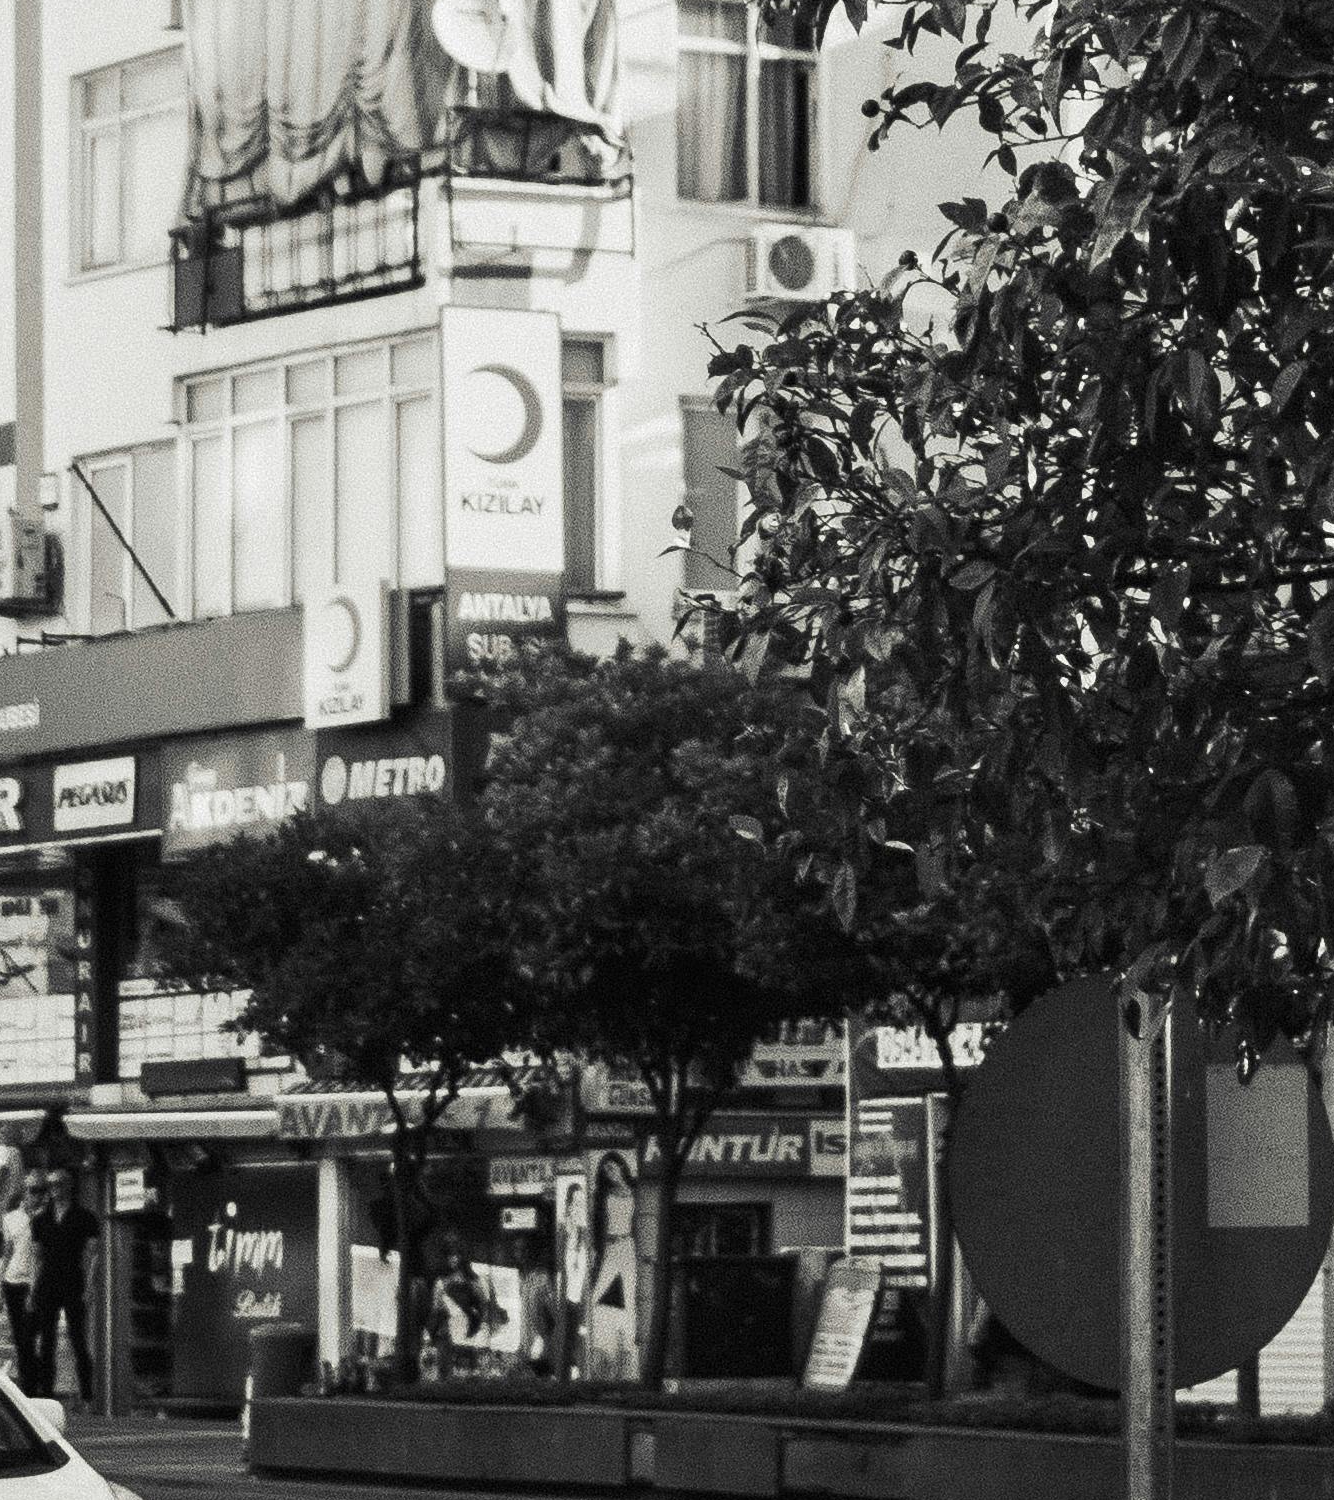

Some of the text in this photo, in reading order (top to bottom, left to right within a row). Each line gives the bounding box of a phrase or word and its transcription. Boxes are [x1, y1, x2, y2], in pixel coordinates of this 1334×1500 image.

[461, 492, 546, 517] KIZILAY
[459, 591, 554, 622] ANTALYA
[347, 754, 445, 801] METRO
